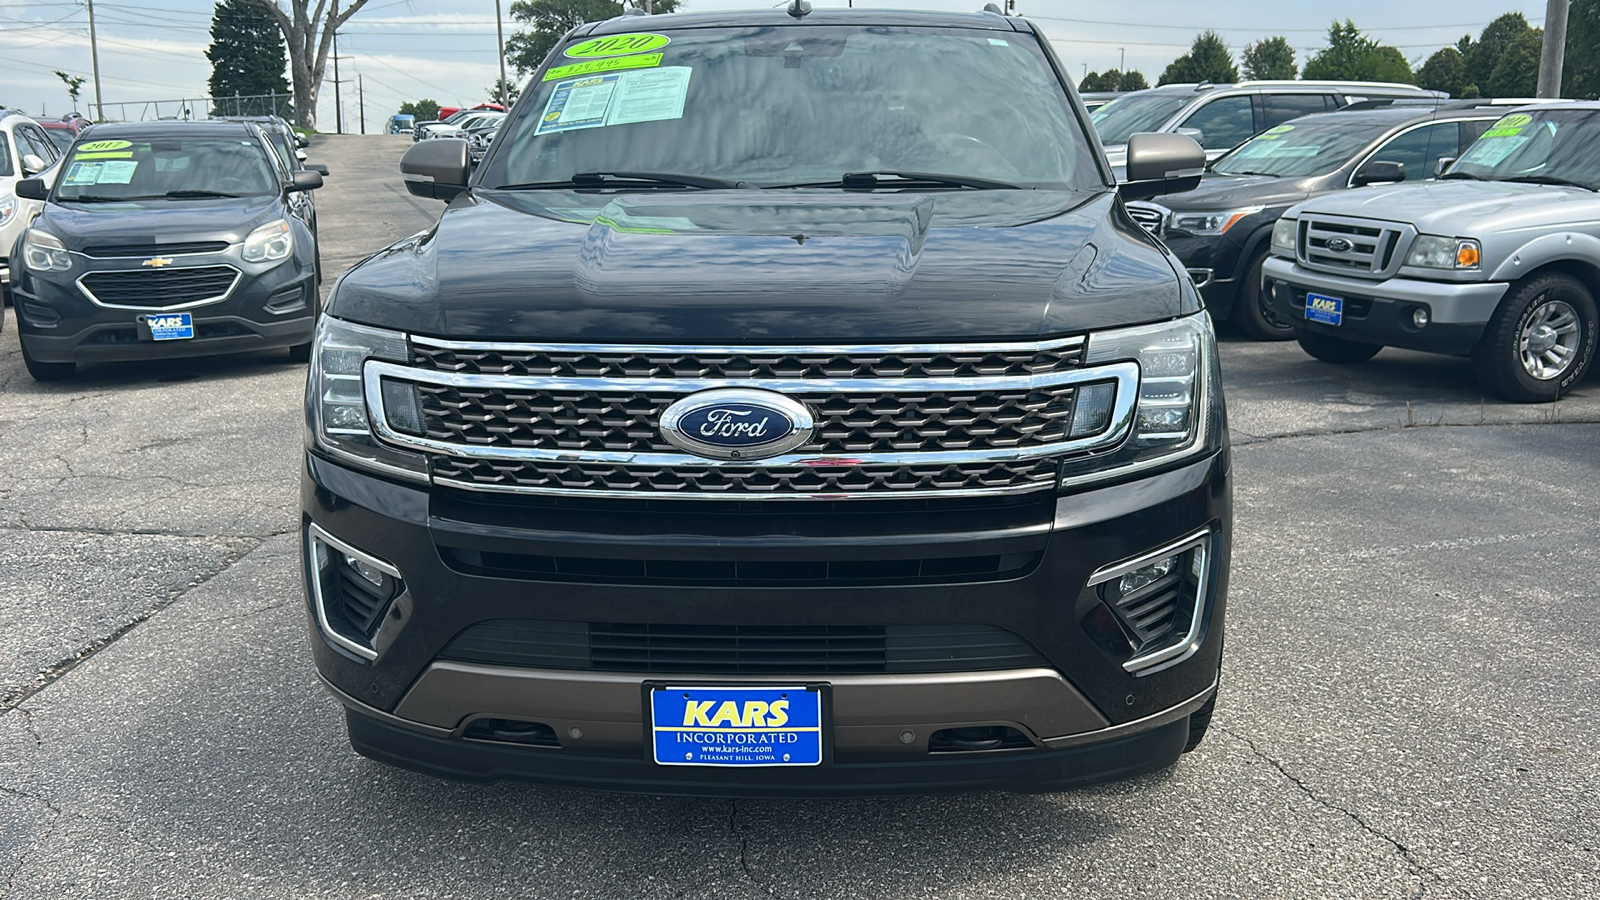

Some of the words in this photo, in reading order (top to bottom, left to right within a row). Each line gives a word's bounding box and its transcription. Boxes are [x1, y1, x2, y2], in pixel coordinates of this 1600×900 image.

[575, 36, 655, 55] 2020
[85, 141, 123, 150] 2017
[1312, 298, 1336, 312] KARS
[147, 317, 183, 327] KARS
[700, 409, 769, 437] Ford
[682, 699, 790, 728] KARS
[676, 732, 798, 744] INCORPORATED
[701, 745, 772, 753] www.kars-inc.com
